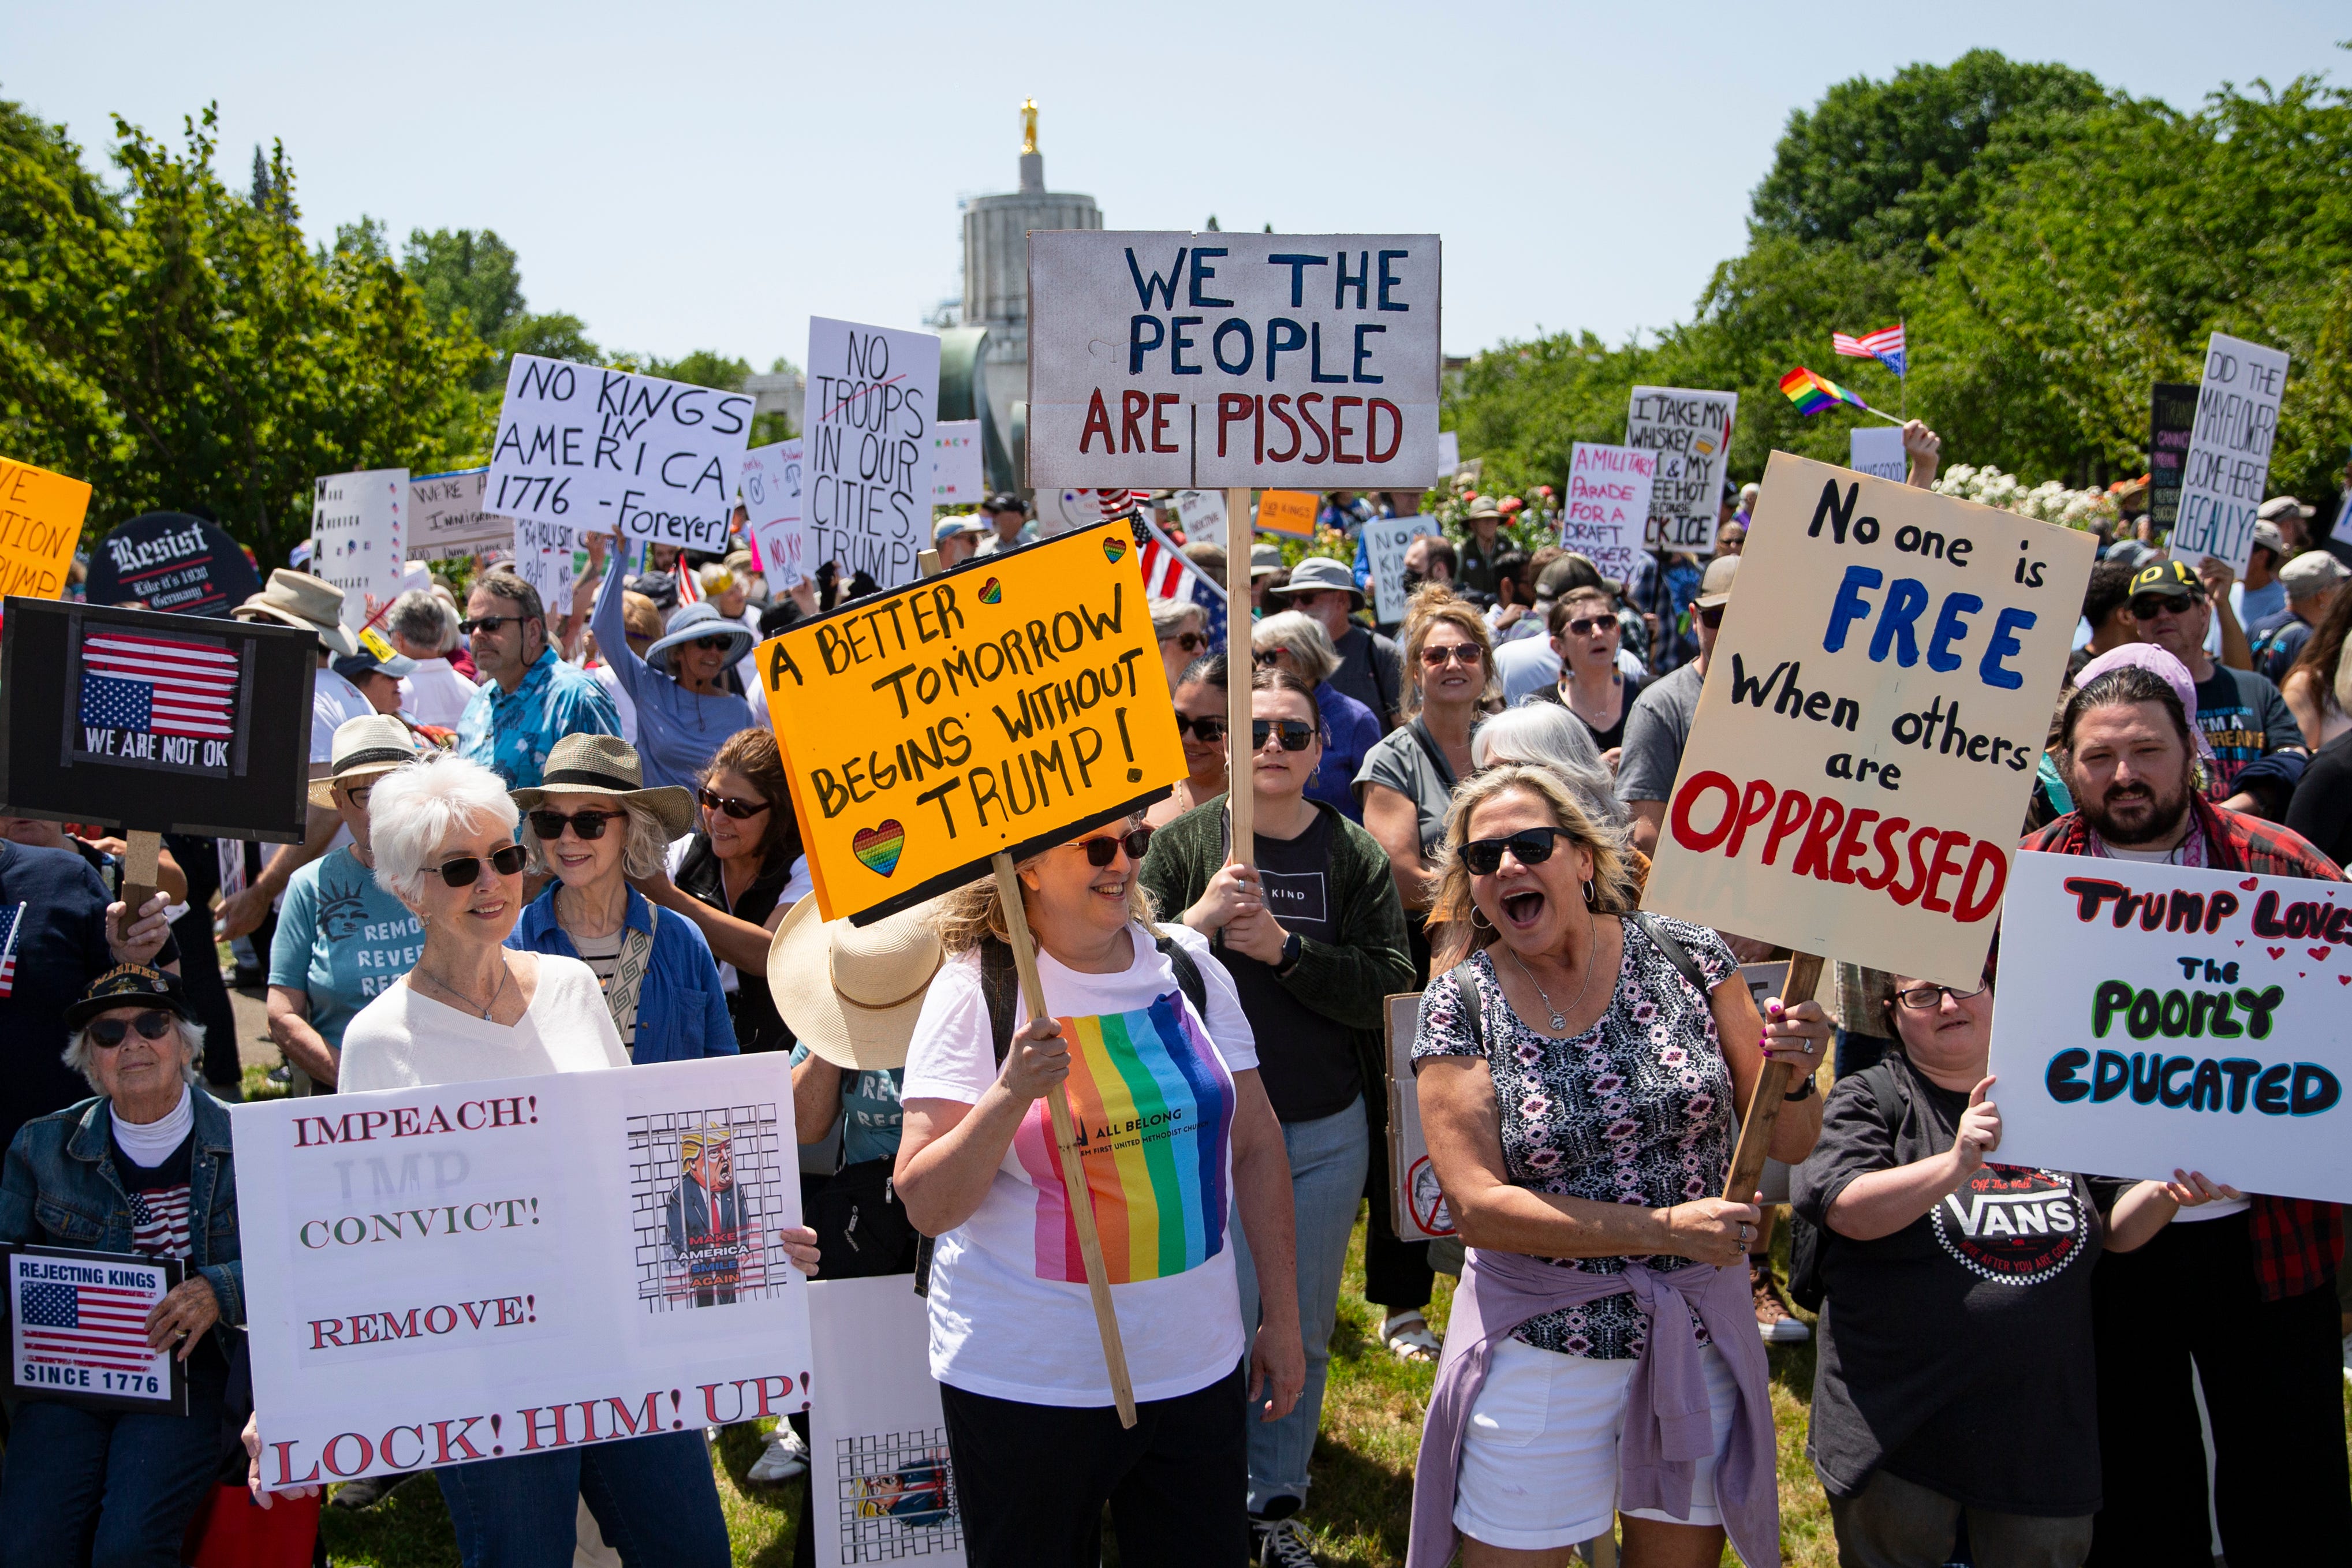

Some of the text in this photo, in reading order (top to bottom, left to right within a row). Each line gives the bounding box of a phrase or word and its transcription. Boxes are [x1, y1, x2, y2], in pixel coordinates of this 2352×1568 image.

[1125, 247, 1409, 311] WE THE
[848, 330, 888, 380] NO
[1129, 314, 1386, 383] PEOPLE
[2208, 350, 2281, 397] DID THE
[518, 361, 752, 434] NO KINGS
[816, 375, 923, 439] TROOPS
[1633, 395, 1727, 431] I TAKE MY
[602, 412, 646, 440] IN
[1079, 386, 1402, 465] ARE PISSED
[1629, 424, 1692, 457] WHISKEY
[2194, 387, 2276, 456] MAYFLOWER
[494, 422, 725, 501] AMERICA
[814, 425, 919, 494] IN OUR
[1574, 448, 1588, 472] A
[1591, 448, 1656, 477] MILITARY
[1667, 459, 1679, 477] &
[1685, 456, 1712, 479] MY
[2186, 449, 2264, 502] COME HERE
[497, 475, 569, 514] 1776
[813, 475, 917, 545] CITIES,
[1571, 476, 1635, 501] PARADE
[1677, 481, 1710, 502] HOT
[0, 510, 70, 559] TION
[1566, 522, 1622, 544] DRAFT
[1570, 502, 1625, 523] FOR A
[1674, 517, 1711, 545] ICE
[1807, 479, 2047, 588] No one is
[2175, 494, 2258, 562] LEGALLY?
[106, 521, 208, 573] Resist
[770, 584, 965, 692] A BETTER
[1822, 564, 2037, 690] FREE
[872, 583, 1122, 719] TOMORROW
[811, 647, 1143, 819] BEGINS WITHOUT
[1731, 653, 2030, 771] When others
[2231, 714, 2244, 730] A
[85, 727, 229, 767] WE ARE NOT OK
[1825, 753, 1902, 790] are
[1671, 770, 2007, 923] OPPRESSED
[1272, 889, 1304, 899] KIND
[364, 917, 420, 942] REMO
[2045, 1048, 2342, 1117] EDUCATED
[293, 1095, 539, 1147] IMPEACH!
[1094, 1144, 1112, 1154] FIRST
[1114, 1138, 1140, 1150] UNITED
[1142, 1129, 1182, 1144] METHODIST
[1183, 1120, 1209, 1134] CHURCH
[1096, 1108, 1182, 1139] ALL BELONG
[1972, 1179, 1989, 1192] Off
[1992, 1179, 2008, 1189] The
[2011, 1177, 2032, 1189] Wall
[300, 1197, 540, 1250] CONVICT!
[1944, 1188, 2075, 1235] VANS
[678, 1245, 750, 1261] AMERICA
[689, 1233, 737, 1246] MAKE
[1980, 1253, 2010, 1272] AFTER
[2013, 1261, 2033, 1272] YOU
[2035, 1253, 2054, 1269] ARE
[2052, 1236, 2074, 1259] GONE
[20, 1262, 156, 1289] REJECTING KINGS
[692, 1260, 738, 1273] SMILE
[692, 1274, 740, 1287] AGAIN
[308, 1294, 537, 1350] REMOVE!
[24, 1364, 158, 1393] SINCE 1776
[270, 1371, 812, 1486] LOCK! HIM! UP!
